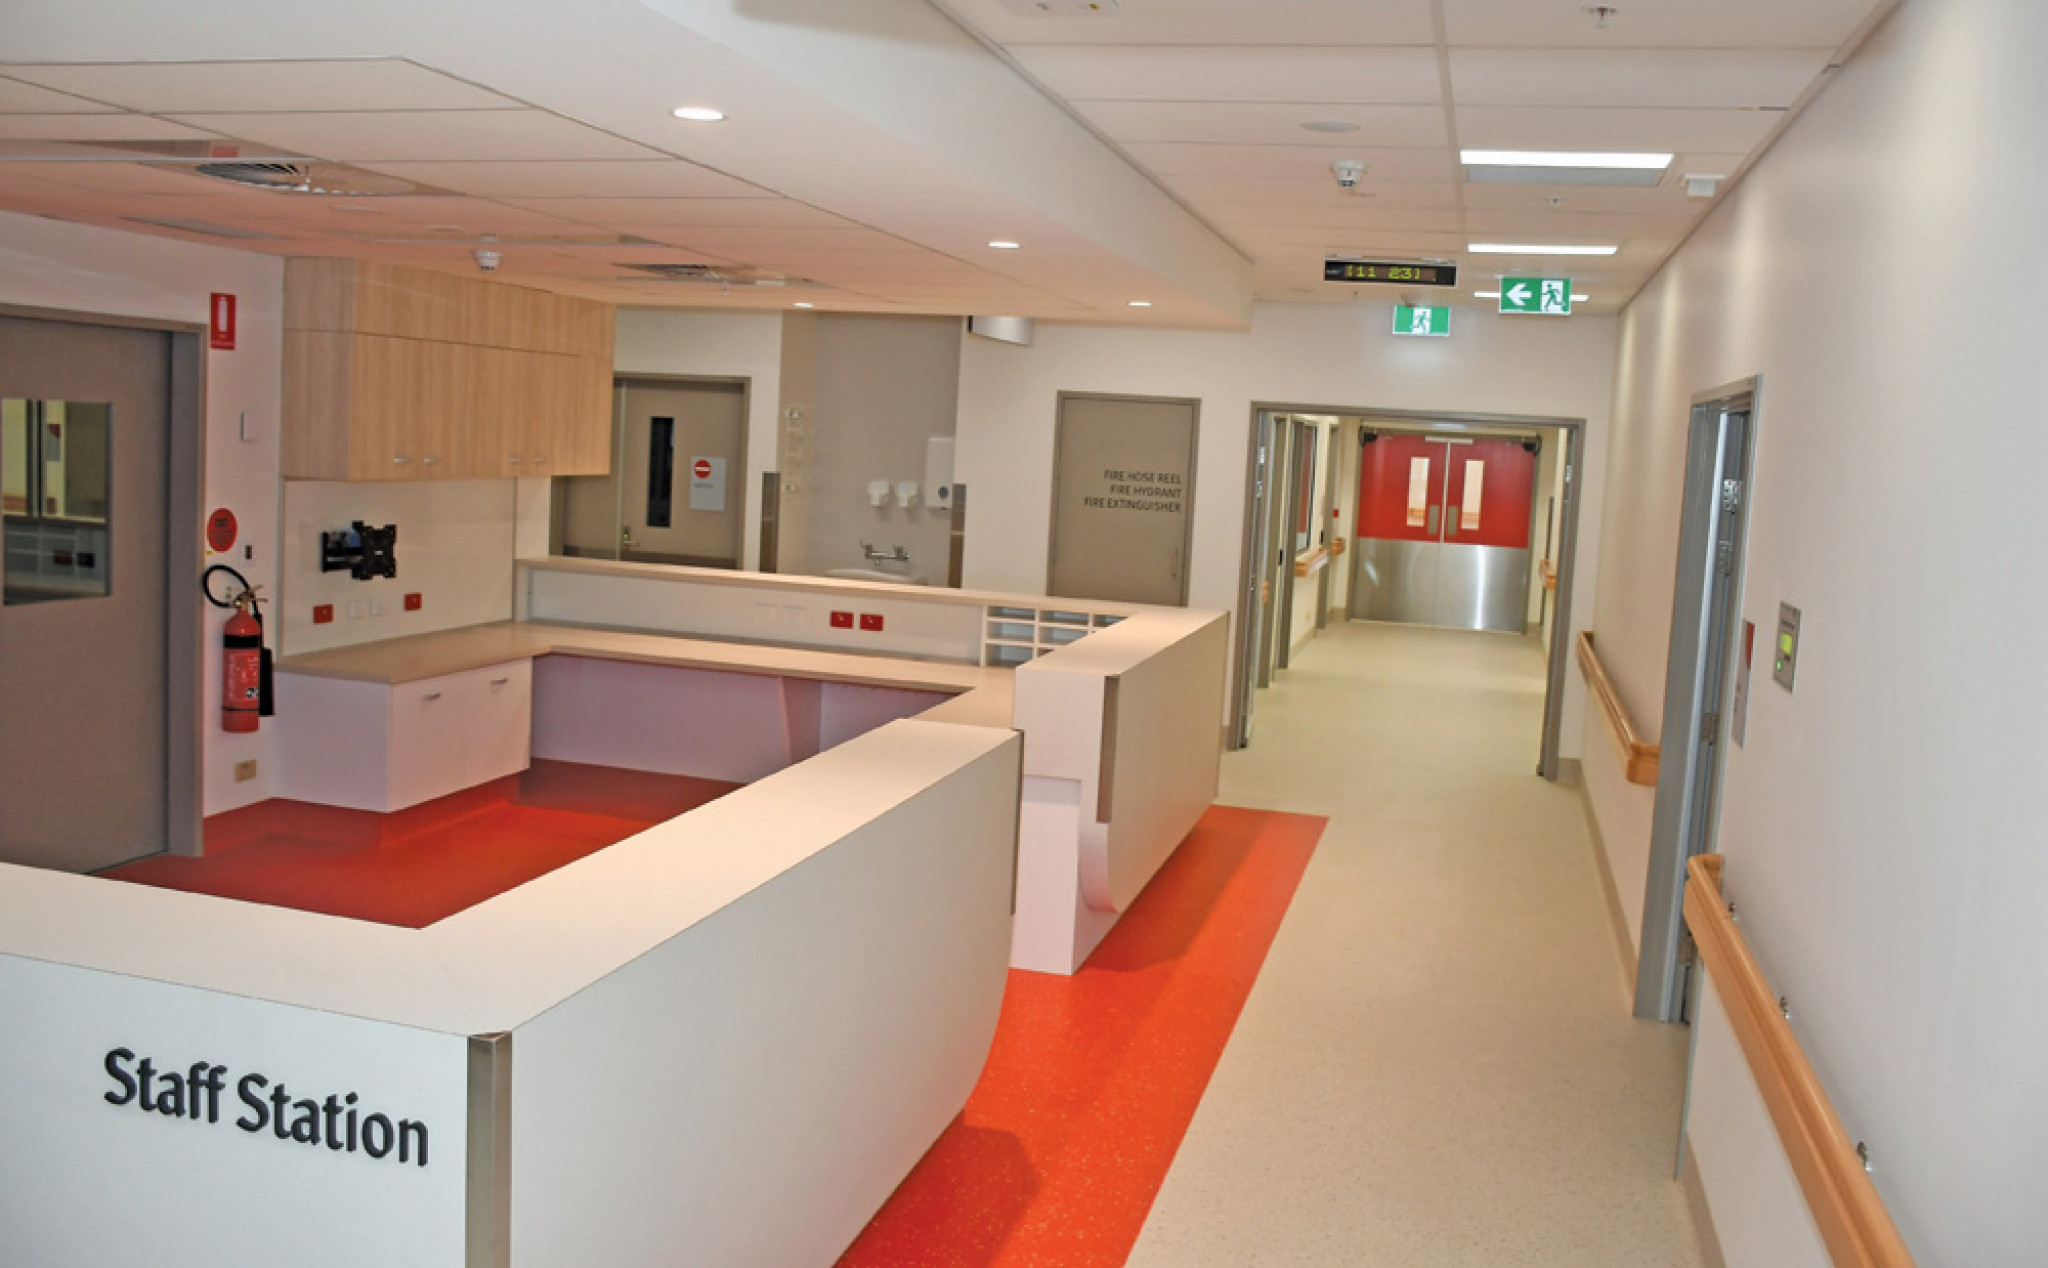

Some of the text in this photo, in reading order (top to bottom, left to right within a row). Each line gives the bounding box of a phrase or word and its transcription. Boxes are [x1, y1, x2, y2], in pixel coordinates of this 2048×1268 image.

[1104, 469, 1182, 484] FIRE HOSE REEL
[1110, 484, 1182, 498] FIRE HYDRANT
[1084, 496, 1182, 512] FIRE EXTINGUISHER
[104, 1047, 429, 1167] Staff Station
